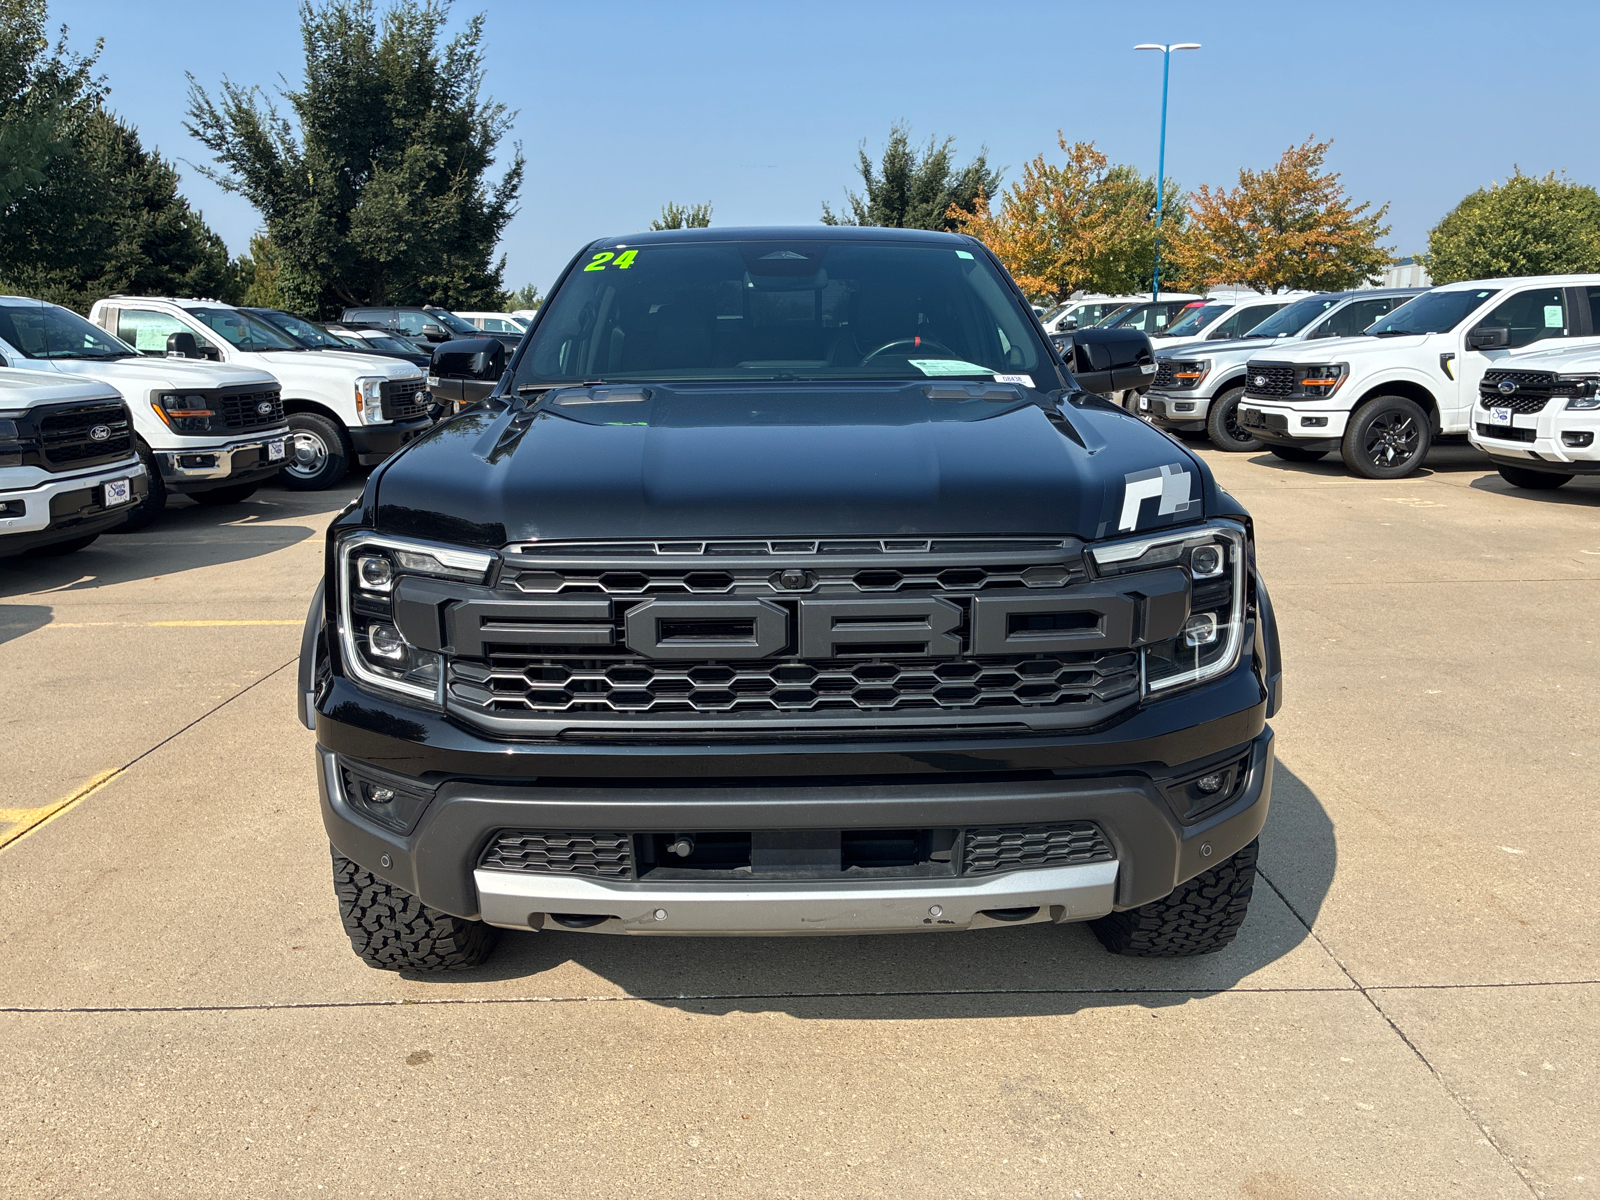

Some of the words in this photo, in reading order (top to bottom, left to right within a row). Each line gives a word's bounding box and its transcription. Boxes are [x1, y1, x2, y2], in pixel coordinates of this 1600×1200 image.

[583, 249, 639, 271] 24
[92, 427, 110, 439] Ford
[446, 597, 1141, 661] FORD
